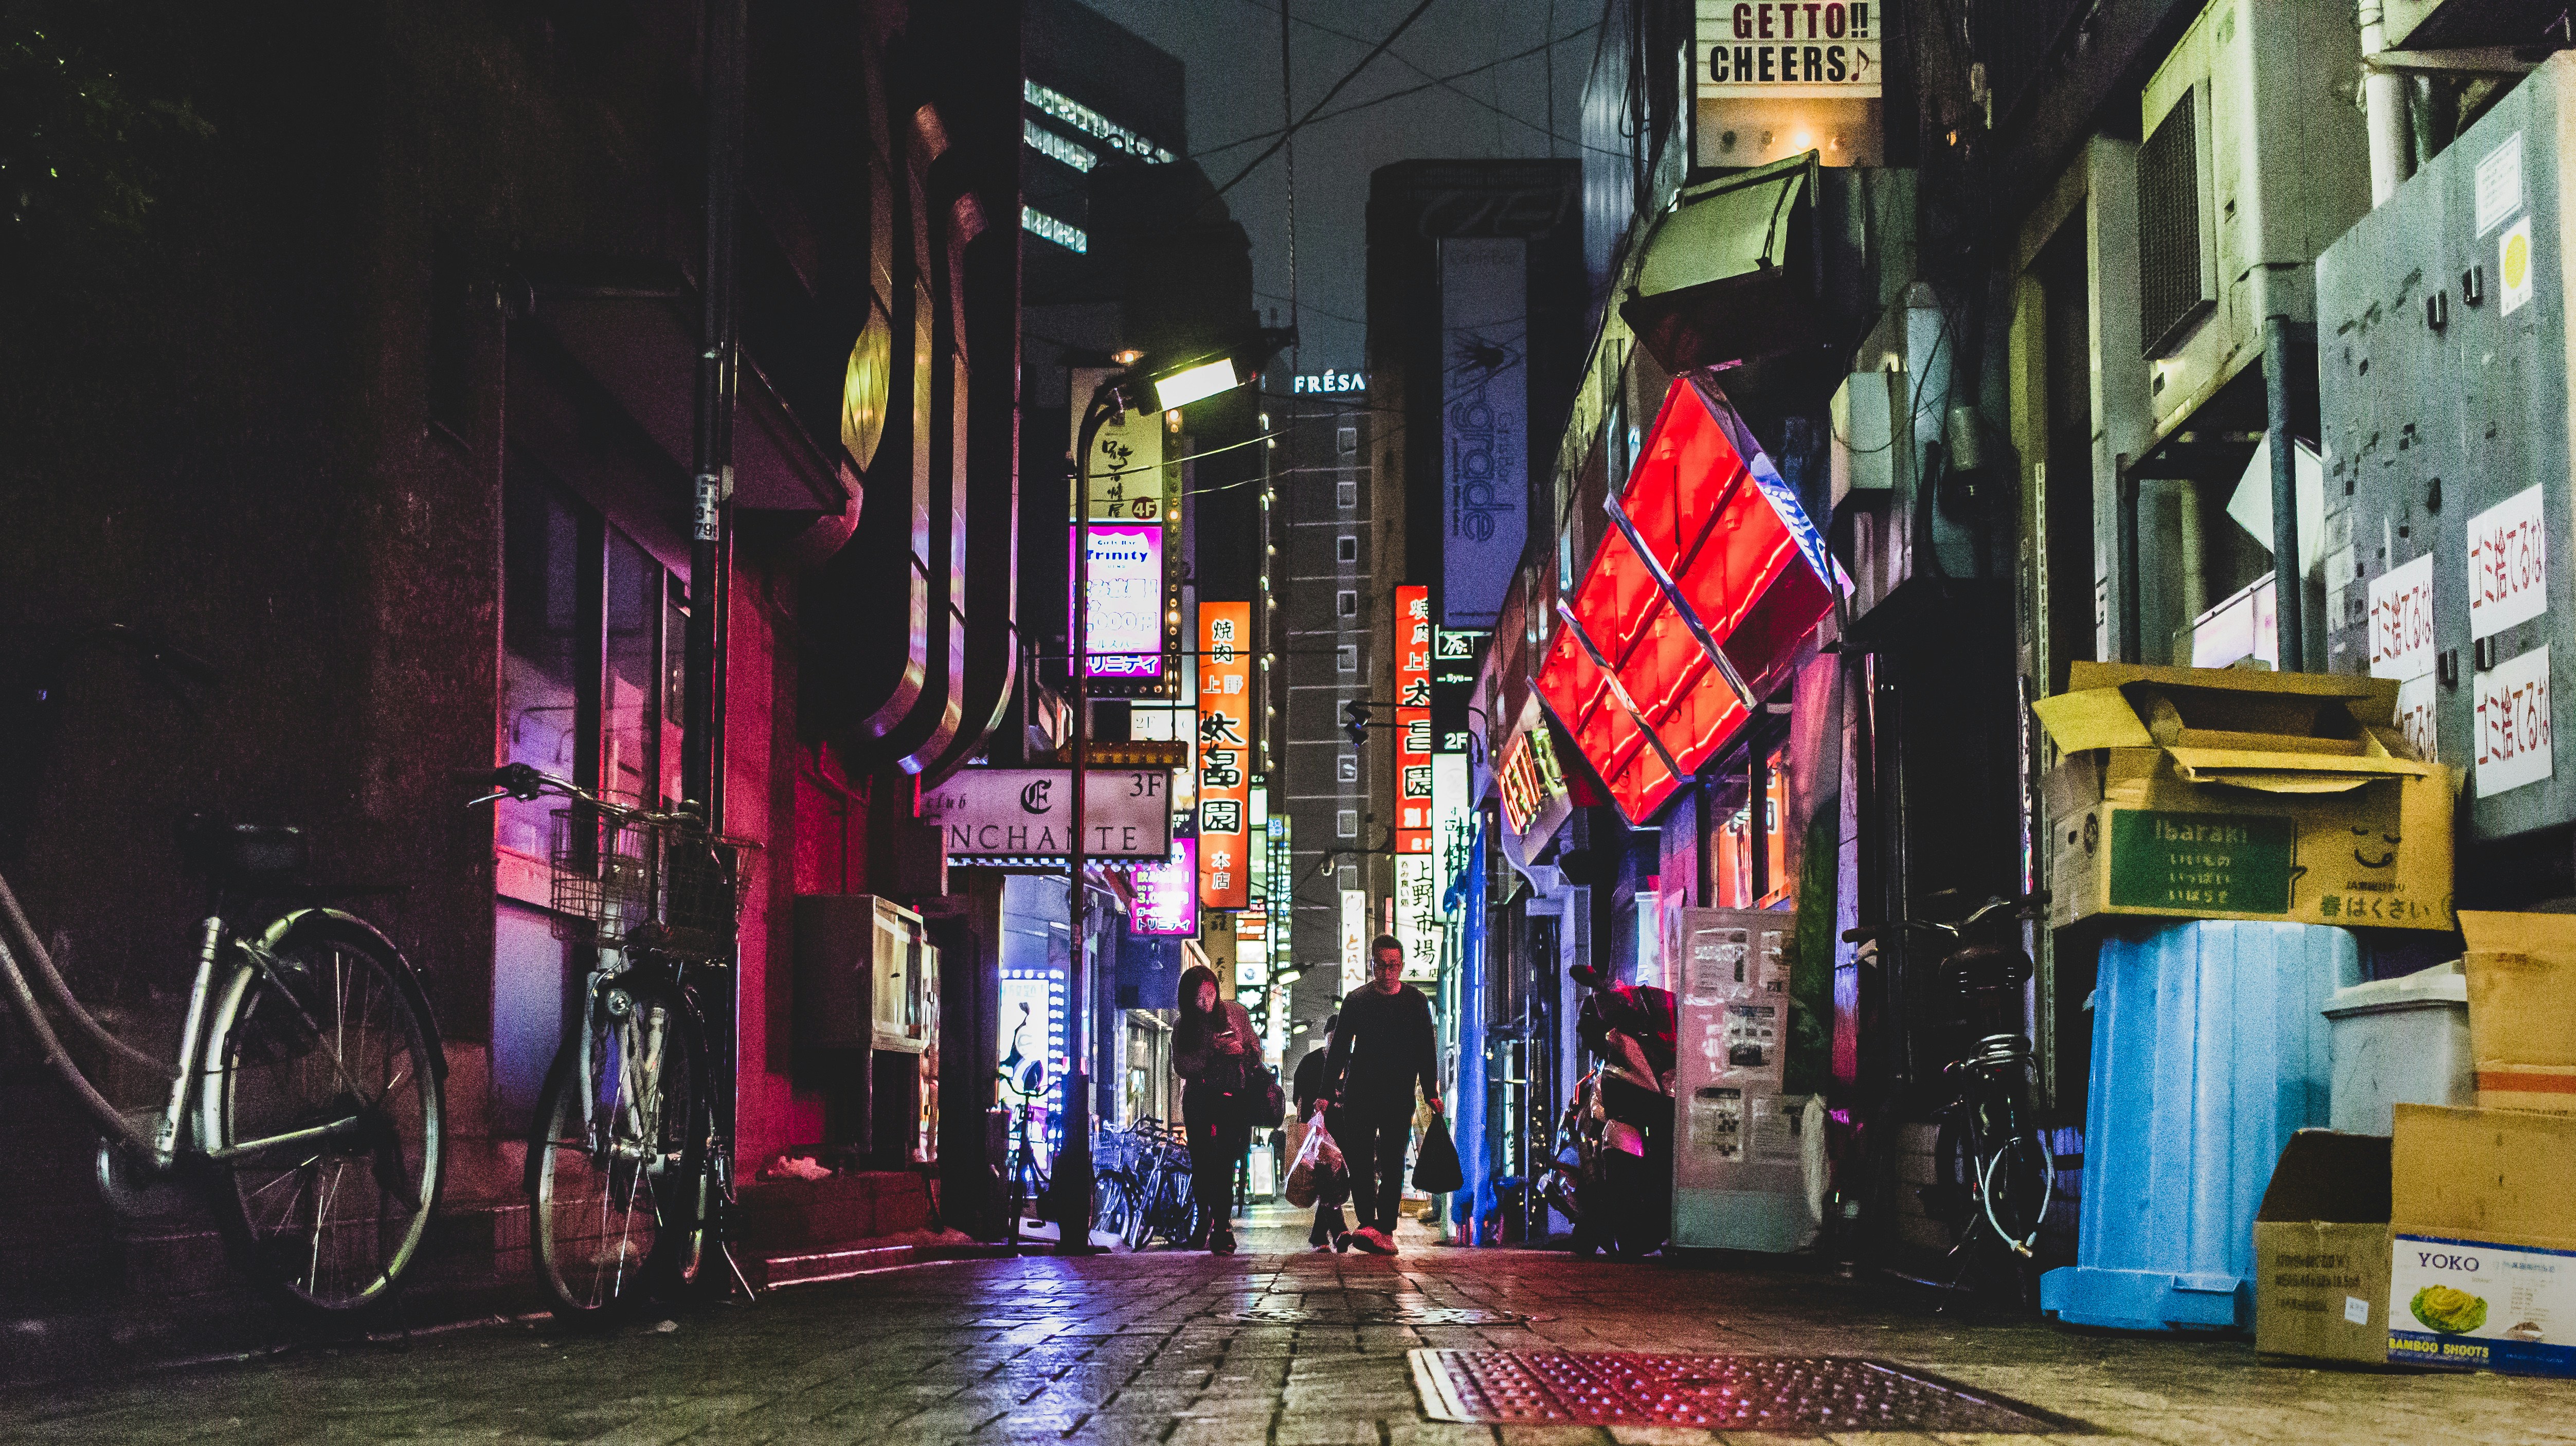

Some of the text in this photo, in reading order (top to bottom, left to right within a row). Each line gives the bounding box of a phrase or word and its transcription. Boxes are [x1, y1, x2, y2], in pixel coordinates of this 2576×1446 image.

[1733, 3, 1868, 39] GETTO!!
[1133, 502, 1155, 516] 4F
[1087, 550, 1148, 563] Trinity
[2471, 515, 2543, 609] ゴミ捨てるな
[2371, 581, 2431, 664] ゴミ捨てるな
[1212, 619, 1235, 665] 焼肉
[1086, 656, 1159, 674] リニティ
[1202, 675, 1244, 694] 上野
[2477, 676, 2549, 765] ゴミ捨てるな
[1444, 732, 1469, 750] 2F
[1130, 773, 1163, 797] 3F
[927, 816, 1138, 852] NCHATE
[1211, 851, 1231, 890] 本店
[1412, 860, 1437, 965] 上野市場
[2320, 895, 2430, 919] 春はくさい
[1137, 918, 1191, 930] トリニティ
[2418, 1252, 2480, 1272] YOKO
[2388, 1337, 2439, 1353] BAMBOO
[2443, 1343, 2489, 1359] SHOOTS
